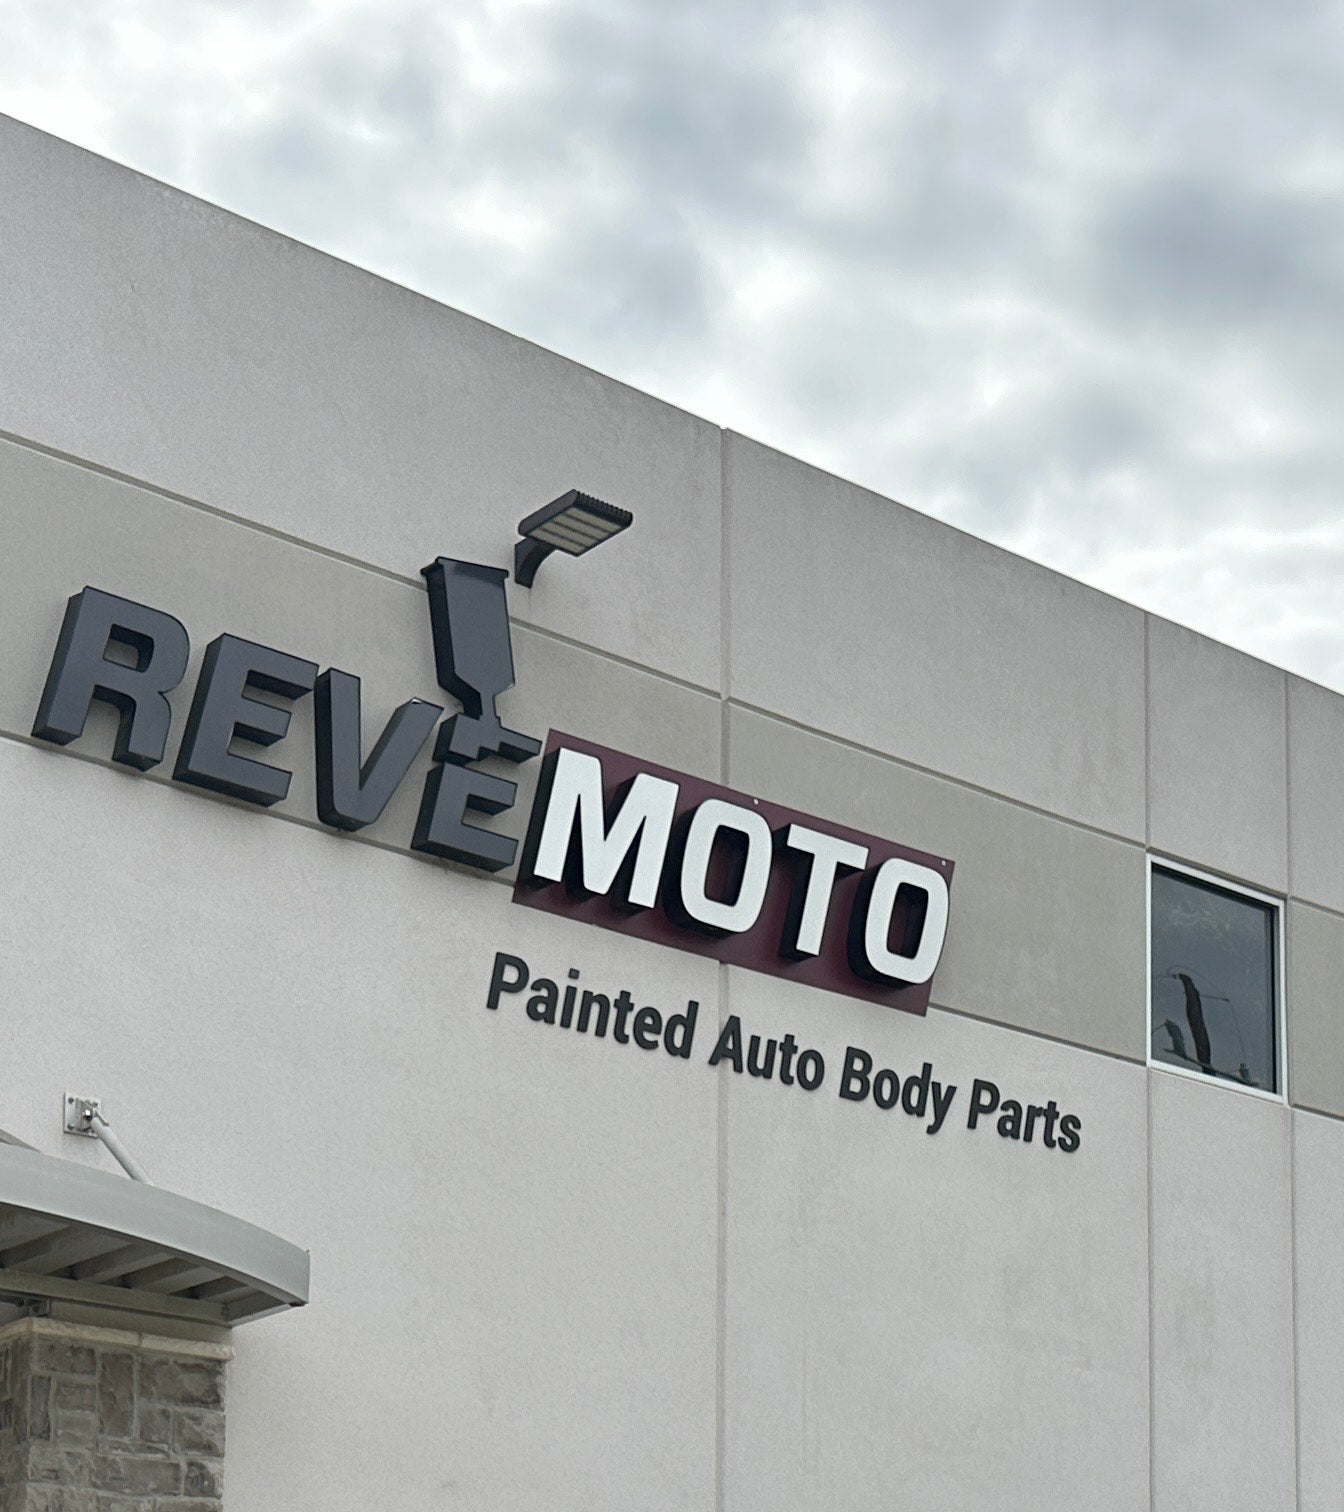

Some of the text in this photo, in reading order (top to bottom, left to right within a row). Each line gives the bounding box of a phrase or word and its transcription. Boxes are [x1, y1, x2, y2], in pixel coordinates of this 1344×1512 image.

[487, 951, 1083, 1154] Painted Auto Body Parts
